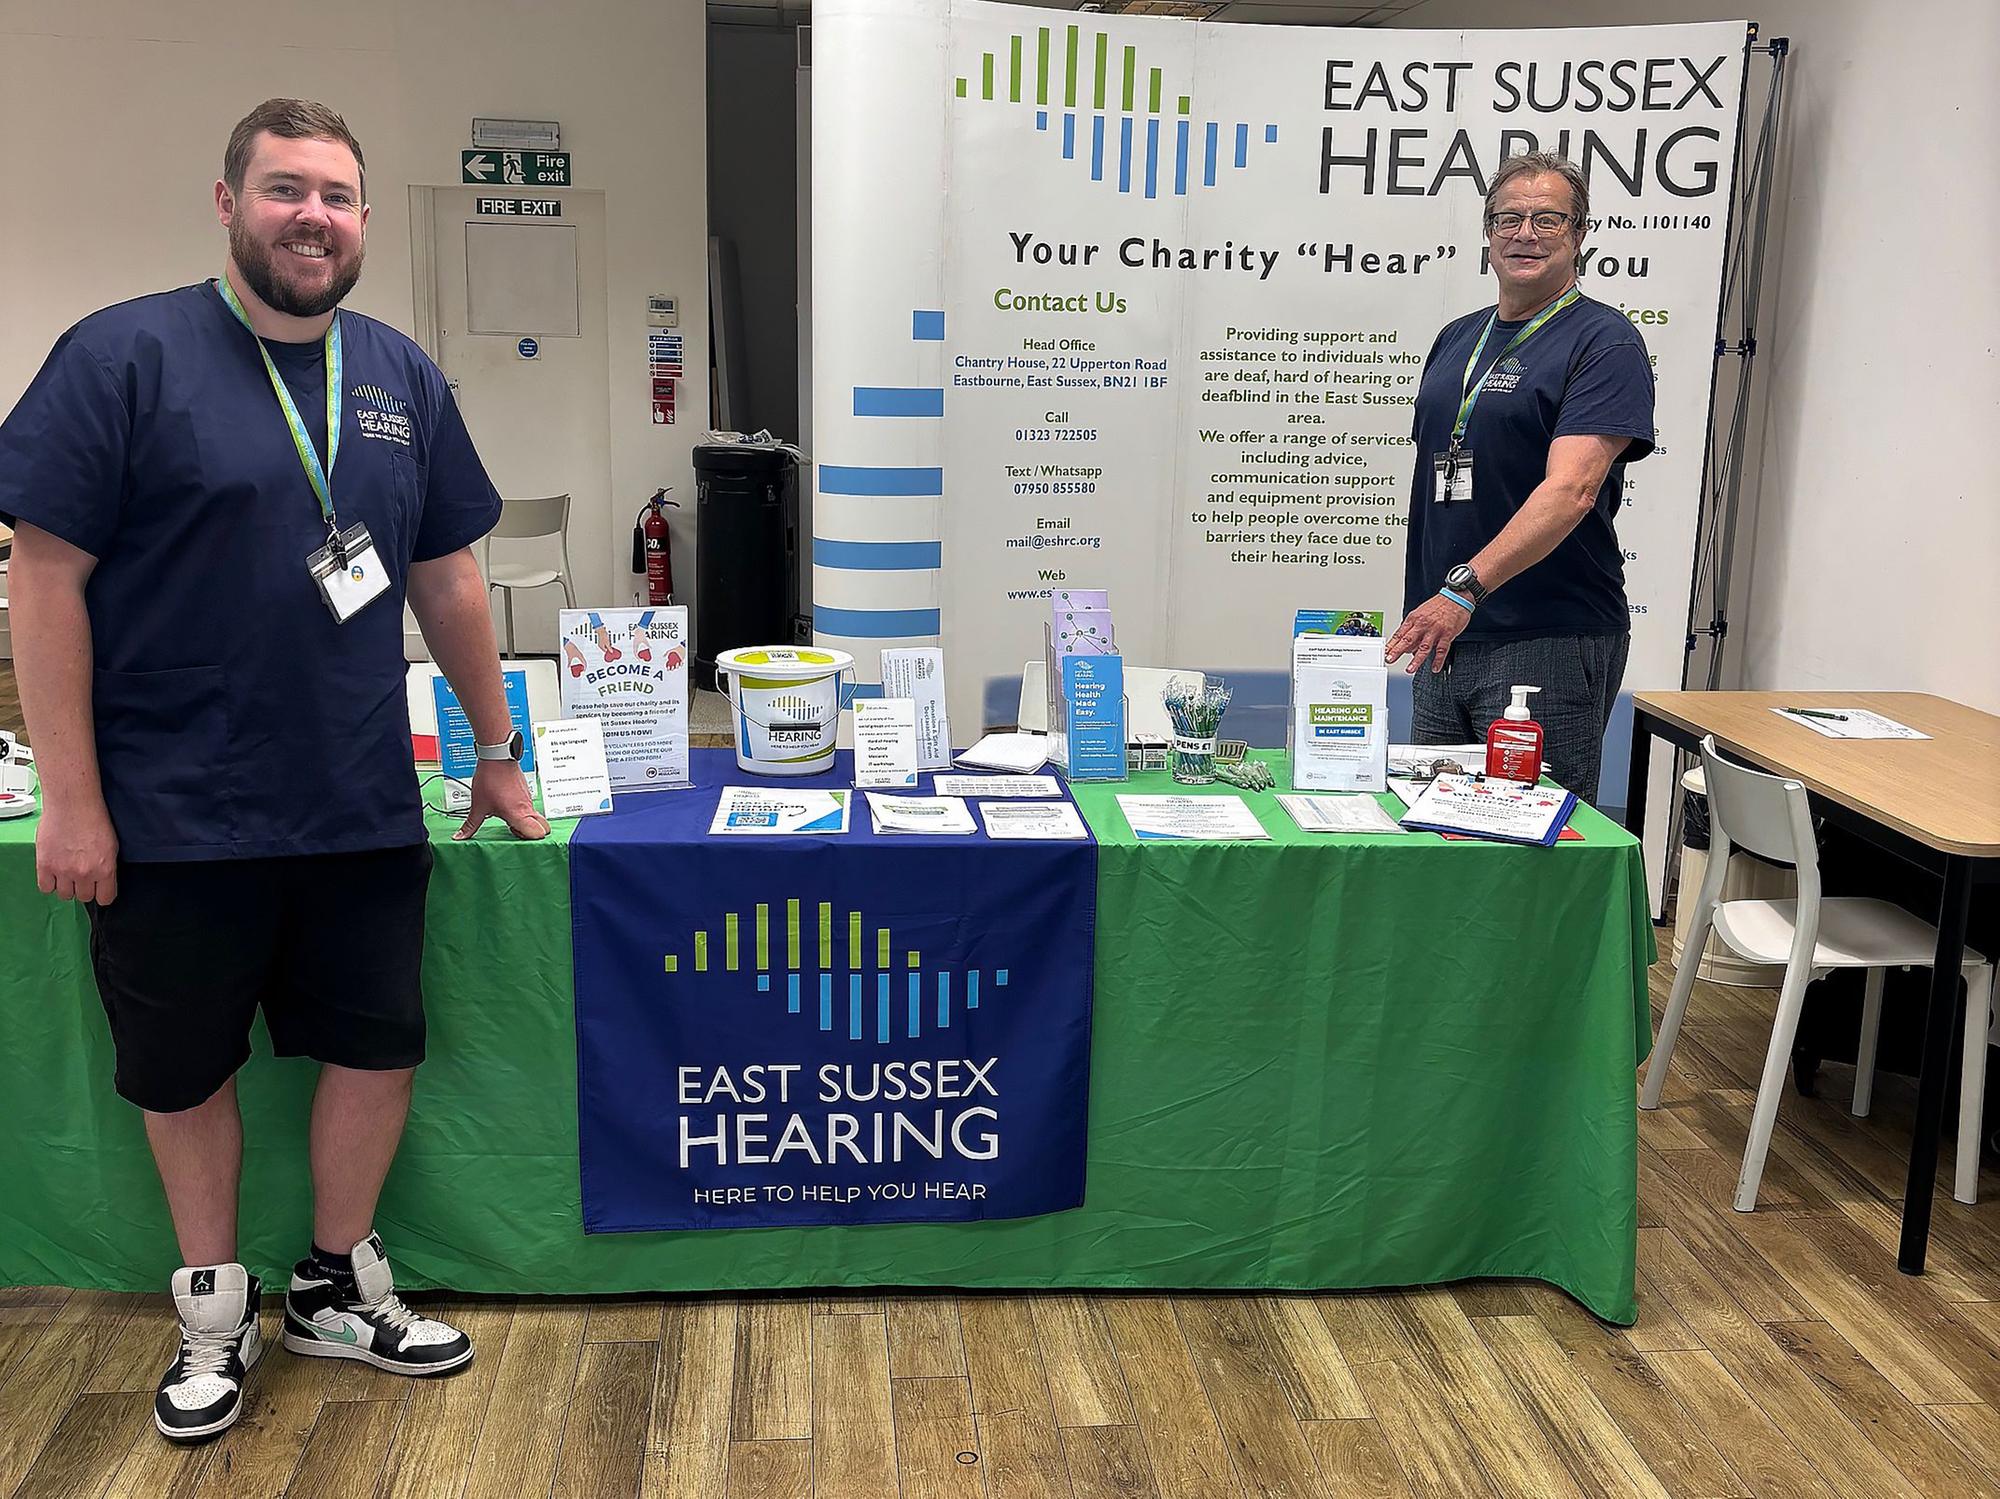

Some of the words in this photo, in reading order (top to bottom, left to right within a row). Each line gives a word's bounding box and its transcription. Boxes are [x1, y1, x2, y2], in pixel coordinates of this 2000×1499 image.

[1325, 60, 1473, 113] EAST
[1492, 56, 1727, 113] SUSSEX
[537, 155, 565, 168] Fire
[538, 169, 565, 182] exit
[482, 200, 515, 214] FIRE
[522, 201, 556, 215] EXIT
[1608, 216, 1636, 229] No.
[1643, 216, 1710, 229] 1101140
[1009, 232, 1099, 266] Your
[1120, 238, 1279, 280] Charity
[994, 289, 1088, 312] Contact
[1096, 291, 1127, 314] Us
[1227, 328, 1298, 344] Providing
[1303, 331, 1364, 345] support
[1369, 331, 1397, 343] and
[1024, 339, 1054, 350] Head
[1059, 339, 1095, 351] Office
[955, 356, 1003, 370] Chantry
[1008, 357, 1049, 370] House,
[1052, 358, 1065, 368] 22
[1070, 358, 1130, 371] Upperton
[1135, 359, 1167, 370] Road
[1200, 349, 1276, 362] assistance
[1282, 351, 1297, 362] to
[1303, 350, 1383, 364] individuals
[1389, 352, 1421, 364] who
[954, 375, 1024, 388] Eastbourne,
[1027, 376, 1052, 386] East
[1056, 376, 1100, 388] Sussex,
[1103, 377, 1136, 388] BN21
[1145, 377, 1167, 388] 1BF
[1205, 372, 1229, 382] are
[1234, 370, 1270, 384] deaf,
[1274, 370, 1308, 382] hard
[1314, 371, 1331, 383] of
[1334, 372, 1392, 388] hearing
[1397, 374, 1414, 384] or
[1202, 389, 1269, 403] deafblind
[1276, 391, 1289, 403] in
[1295, 391, 1319, 403] the
[1325, 392, 1358, 404] East
[1363, 392, 1414, 405] Sussex
[357, 410, 378, 419] EAST
[380, 413, 409, 426] SUSSEX
[1045, 412, 1068, 423] Call
[1288, 414, 1325, 424] area.
[359, 420, 410, 438] HEARING
[1015, 430, 1050, 441] 01323
[1055, 430, 1097, 440] 722505
[1199, 430, 1224, 442] We
[1230, 431, 1265, 443] offer
[1270, 435, 1278, 443] a
[1283, 435, 1326, 447] range
[1332, 433, 1347, 444] of
[1351, 433, 1412, 445] services
[1242, 451, 1309, 467] including
[1314, 453, 1367, 467] advice,
[1005, 466, 1031, 476] Text
[1211, 472, 1329, 485] communication
[1334, 475, 1395, 488] support
[1014, 483, 1049, 494] 07950
[1053, 483, 1095, 493] 855580
[1208, 492, 1234, 503] and
[1239, 492, 1321, 507] equipment
[1326, 493, 1395, 508] provision
[1037, 518, 1070, 528] Email
[1192, 513, 1207, 523] to
[1213, 511, 1243, 525] help
[1249, 512, 1299, 527] people
[1304, 514, 1379, 525] overcome
[1385, 514, 1408, 526] the
[1006, 536, 1100, 549] mail@eshrc.org
[1206, 531, 1265, 543] barriers
[1271, 532, 1302, 546] they
[1308, 532, 1338, 544] face
[1343, 533, 1371, 545] due
[1376, 534, 1392, 545] to
[1231, 550, 1267, 562] their
[1272, 551, 1328, 566] hearing
[1334, 552, 1365, 564] loss.
[1038, 570, 1065, 580] Web
[587, 664, 651, 684] BECOME
[653, 670, 663, 681] A
[598, 681, 654, 697] FRIEND
[769, 731, 821, 741] HEARING
[1176, 740, 1200, 750] PENS
[678, 1064, 801, 1104] EAST
[819, 1058, 998, 1102] SUSSEX
[679, 1106, 998, 1168] HEARING
[695, 1188, 756, 1204] HERE
[762, 1185, 793, 1202] TO
[802, 1185, 861, 1202] HELP
[868, 1184, 915, 1200] YOU
[925, 1183, 986, 1200] HEAR
